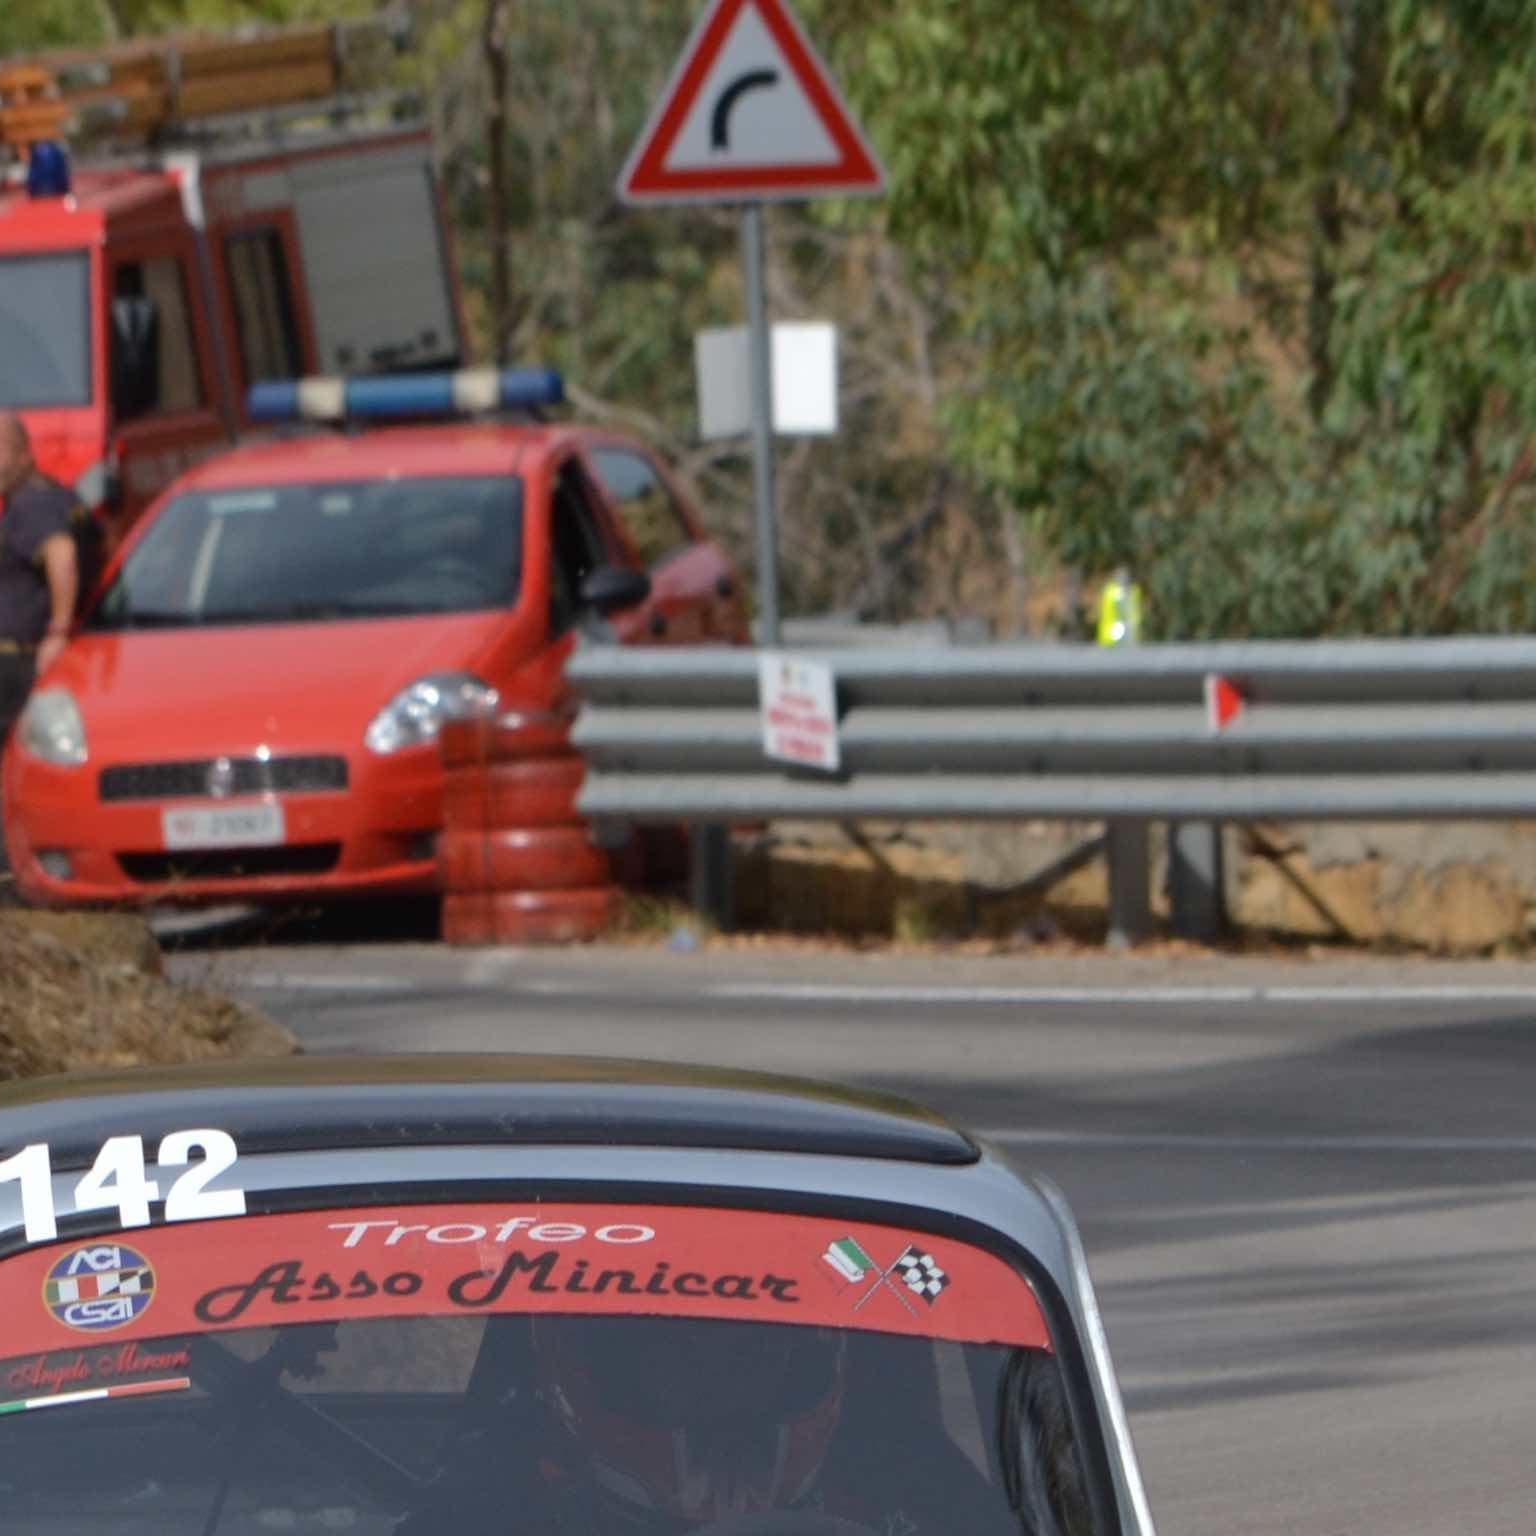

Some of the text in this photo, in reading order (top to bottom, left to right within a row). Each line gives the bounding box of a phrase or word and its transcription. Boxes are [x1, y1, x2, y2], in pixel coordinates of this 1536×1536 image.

[328, 1217, 655, 1248] Trofeo
[67, 1246, 121, 1272] ACI
[194, 1249, 800, 1322] Asso Minicar
